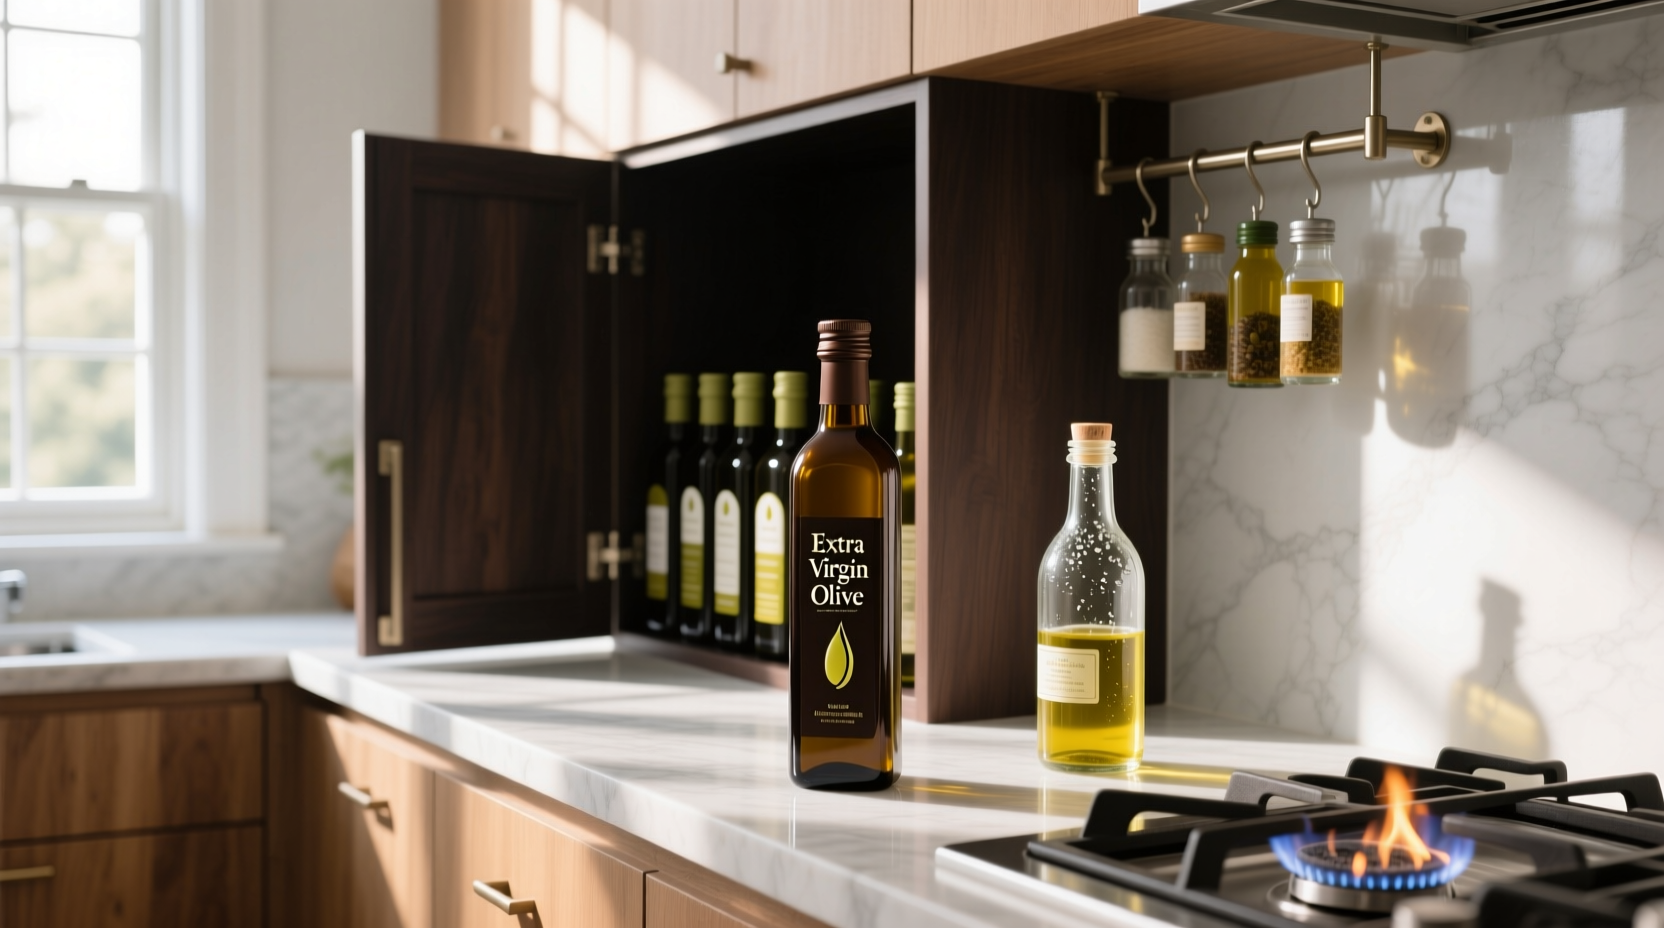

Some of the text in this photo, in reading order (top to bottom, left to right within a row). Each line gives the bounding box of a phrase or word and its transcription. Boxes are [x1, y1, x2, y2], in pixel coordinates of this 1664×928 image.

[811, 533, 864, 554] Extra
[808, 557, 869, 585] Virgin
[811, 584, 864, 606] Olive
